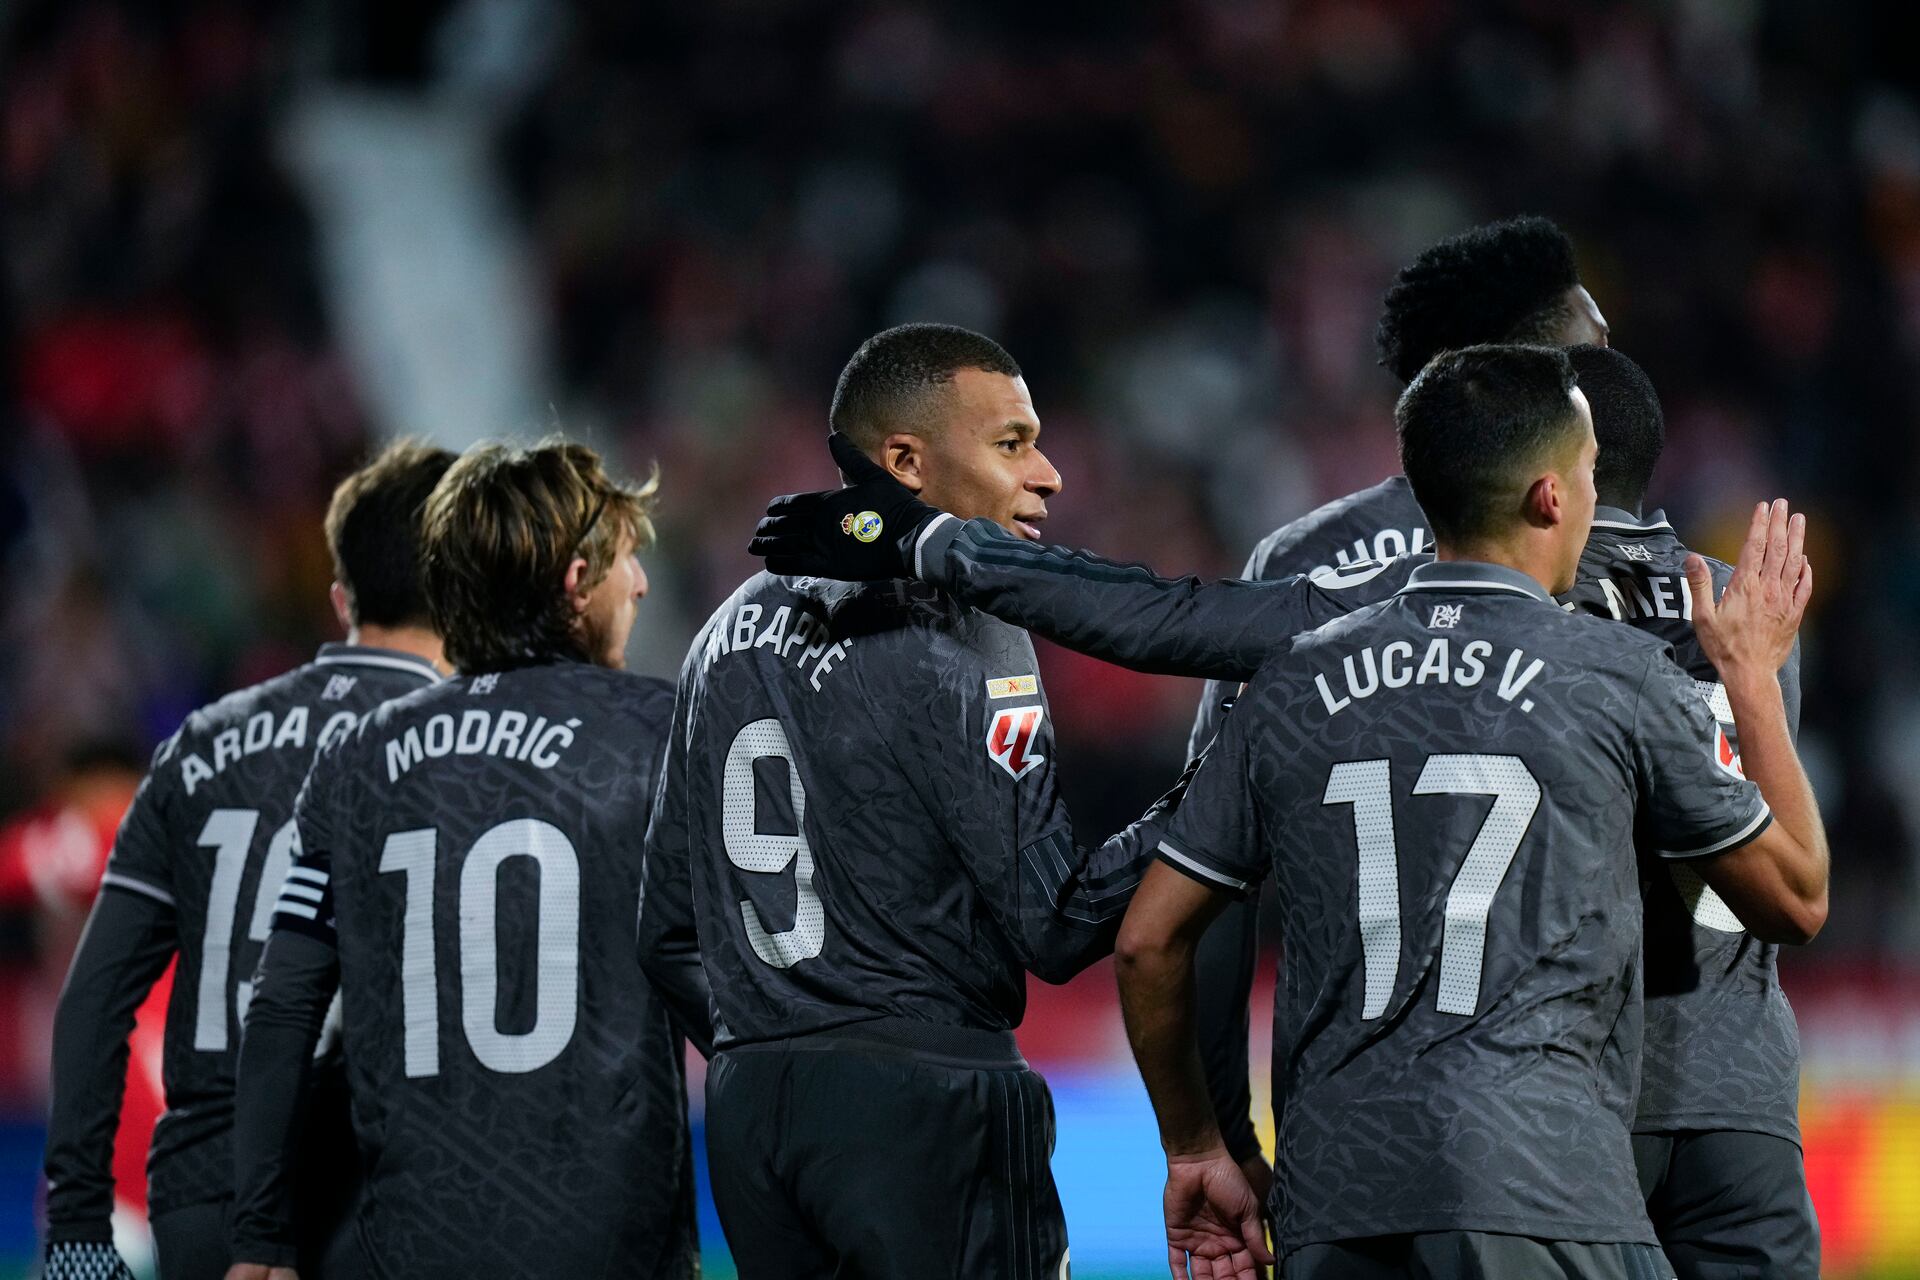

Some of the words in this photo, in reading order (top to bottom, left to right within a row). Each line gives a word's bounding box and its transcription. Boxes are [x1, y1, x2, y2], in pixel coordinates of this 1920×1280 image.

[181, 706, 309, 797] ARDA
[385, 709, 583, 784] MODRIĆ
[1314, 638, 1493, 716] LUCAS
[1496, 647, 1545, 713] V.
[722, 717, 826, 969] 9
[1322, 753, 1542, 1021] 17
[379, 818, 580, 1078] 10
